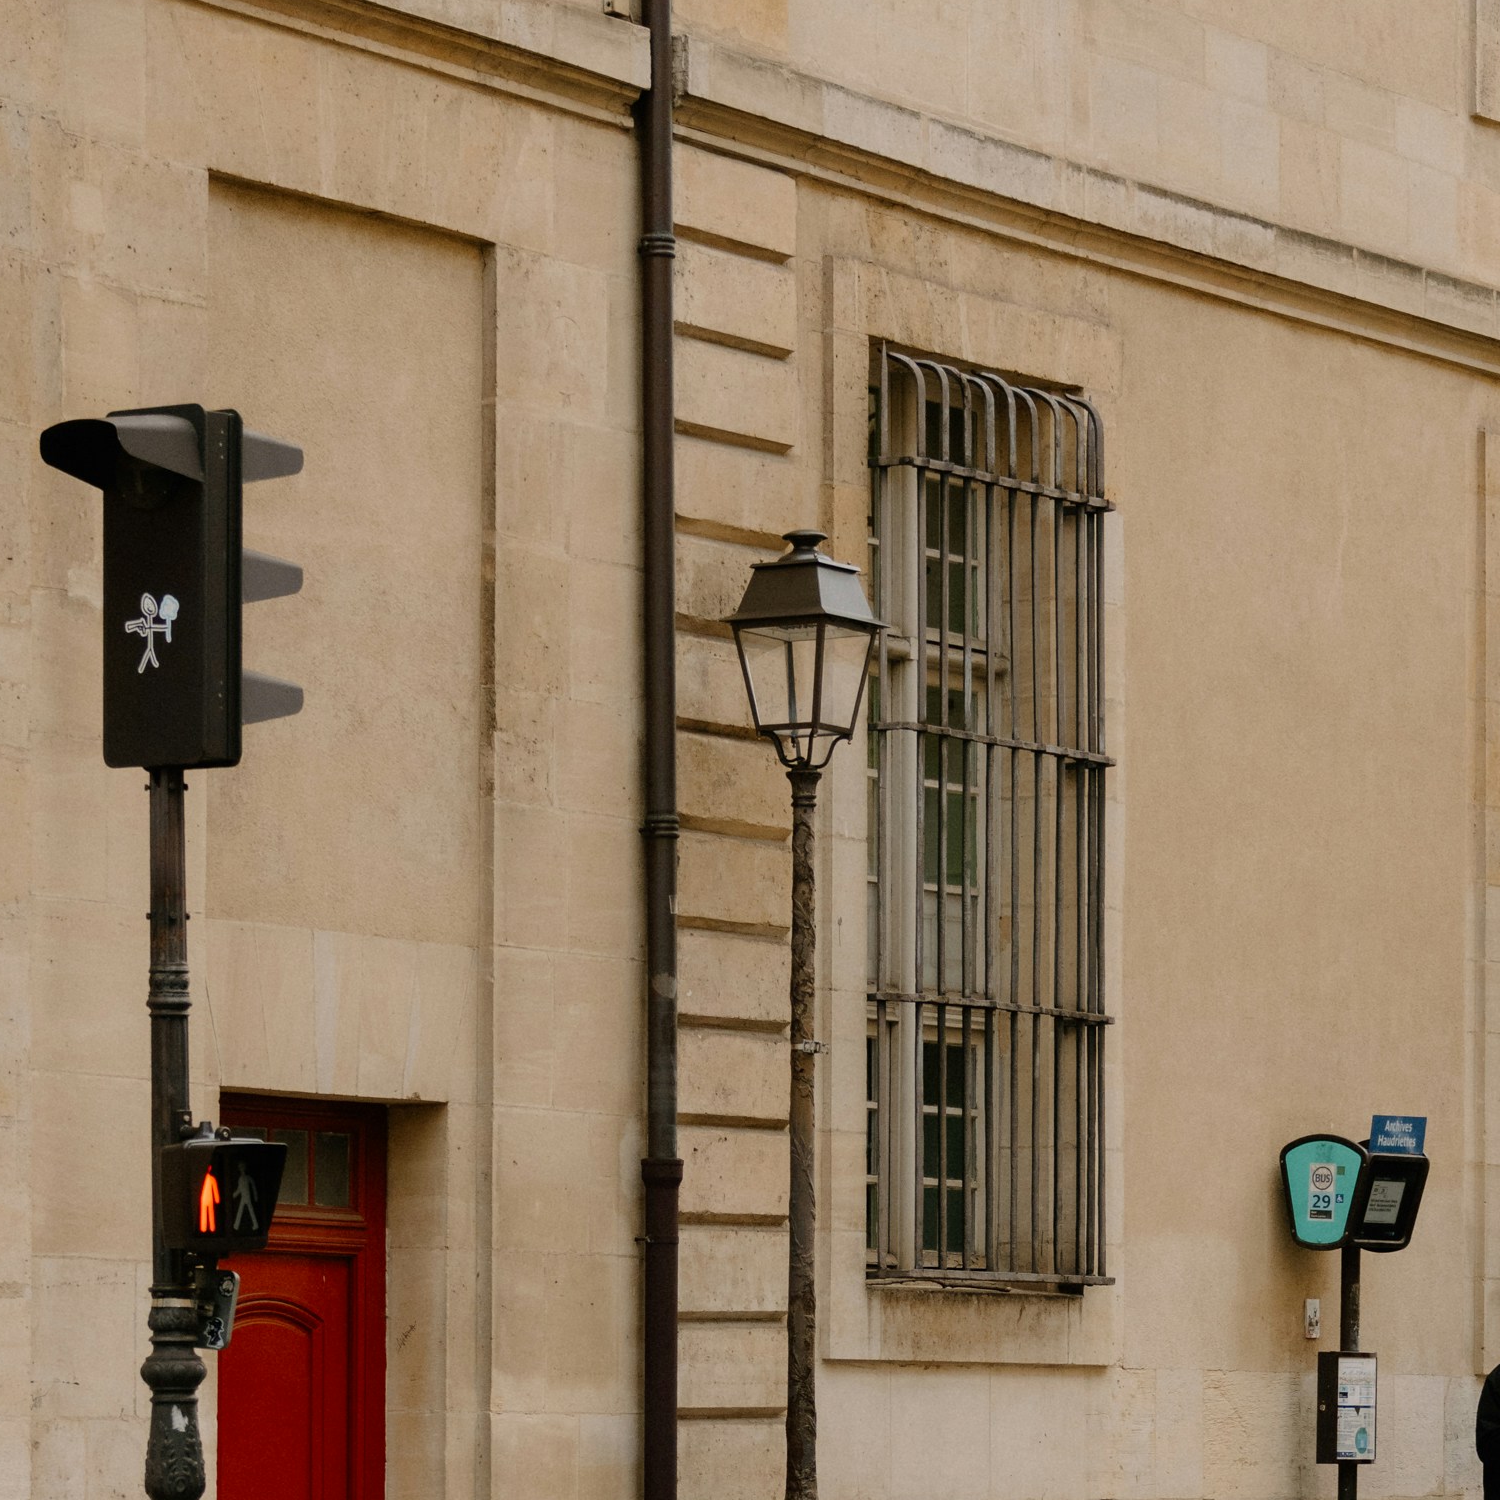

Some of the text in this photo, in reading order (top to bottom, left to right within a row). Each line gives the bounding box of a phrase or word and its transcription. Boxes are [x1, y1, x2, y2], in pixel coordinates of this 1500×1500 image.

[1384, 1120, 1413, 1133] Archives
[1377, 1134, 1416, 1147] Haudriettes
[1315, 1173, 1331, 1184] BUS
[1312, 1194, 1331, 1209] 29
